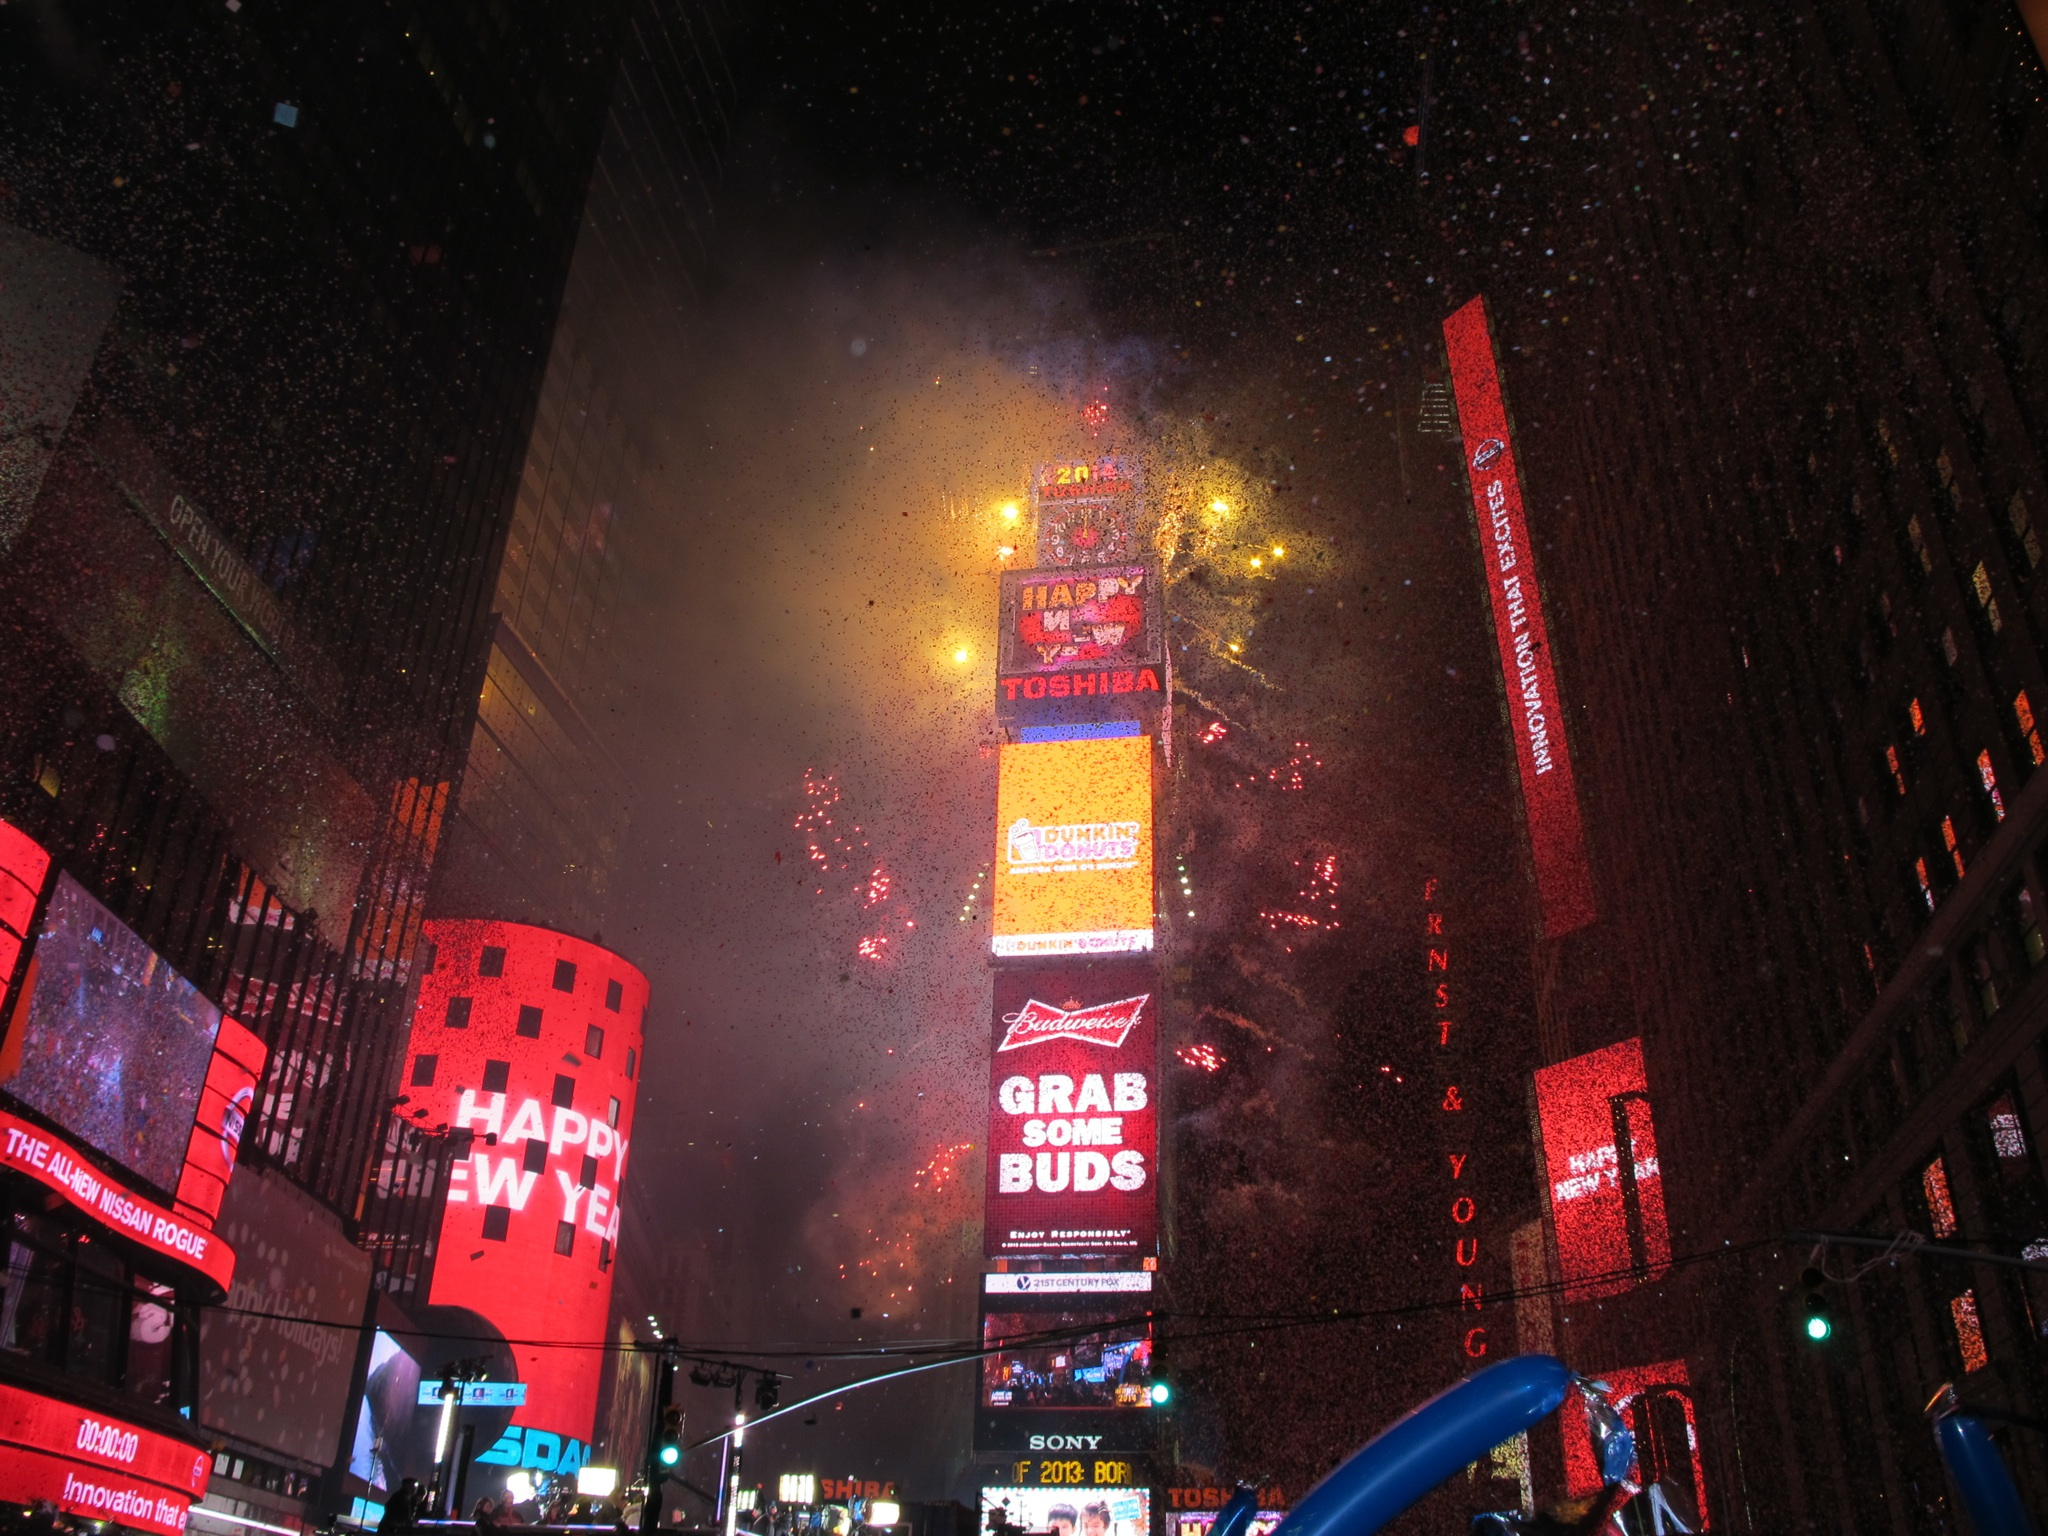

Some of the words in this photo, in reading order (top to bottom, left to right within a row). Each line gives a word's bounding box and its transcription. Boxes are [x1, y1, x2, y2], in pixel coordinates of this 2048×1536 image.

[1487, 480, 1516, 571] EXCITES
[1022, 575, 1143, 611] HAPPY
[1503, 575, 1526, 631] THAT
[1001, 669, 1159, 701] TOSHIBA
[1514, 631, 1552, 775] INNOVATION
[1044, 841, 1133, 860] DONUTS
[1002, 1011, 1142, 1035] Budweiser
[998, 1072, 1149, 1115] GRAB
[456, 1089, 628, 1182] HAPPY
[1022, 1117, 1123, 1148] SOME
[998, 1149, 1148, 1194] BUDS
[6, 1127, 50, 1169] THE
[46, 1151, 102, 1205] ALL-NEW
[98, 1188, 153, 1235] NISSAN
[152, 1217, 207, 1260] ROGUE
[1010, 1230, 1045, 1239] ENJOY
[1449, 1154, 1487, 1357] YOUNG
[1056, 1278, 1100, 1288] CENTURY
[1101, 1277, 1119, 1287] FOX
[77, 1419, 139, 1463] 00:00:00
[1029, 1434, 1102, 1451] SONY
[1011, 1460, 1031, 1483] OF
[1040, 1460, 1085, 1484] 2013:
[63, 1472, 153, 1520] Innovation
[154, 1498, 180, 1527] that
